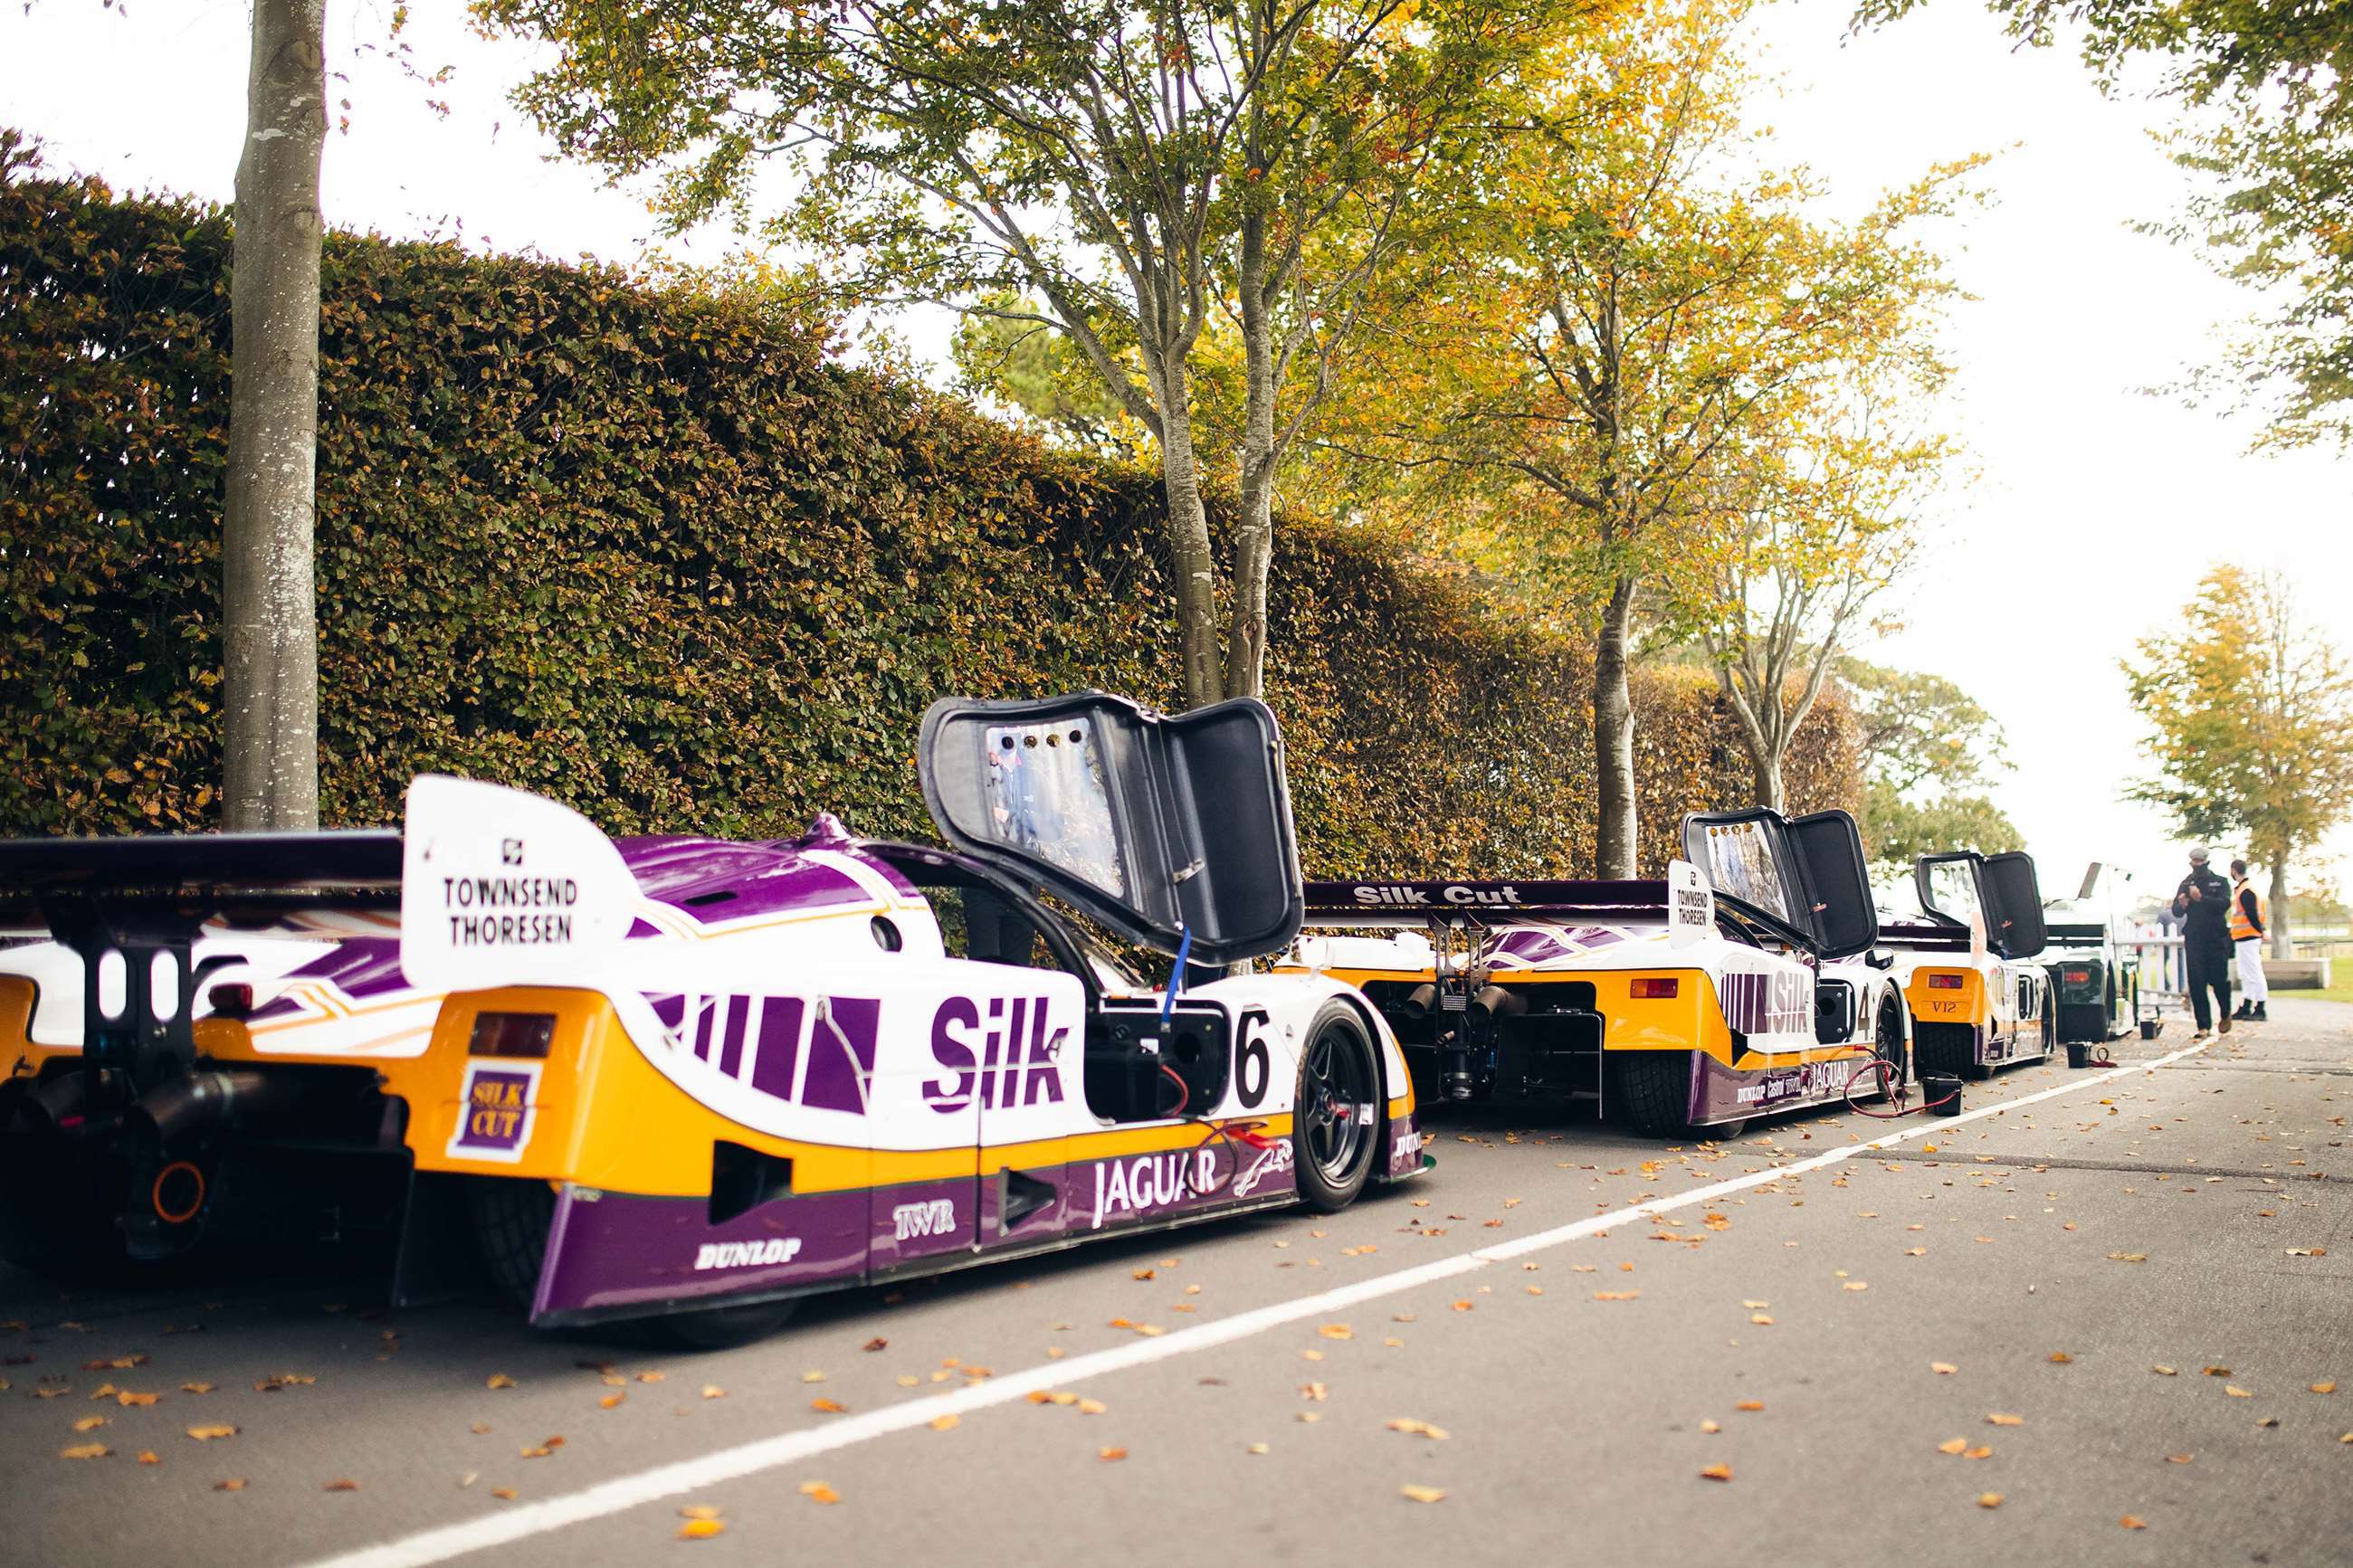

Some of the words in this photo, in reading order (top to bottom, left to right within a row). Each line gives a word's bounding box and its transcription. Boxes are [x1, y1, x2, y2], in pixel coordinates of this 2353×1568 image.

[443, 878, 577, 908] TOWNSEND
[1353, 886, 1432, 904] Silk
[1443, 886, 1522, 904] Cut
[1678, 889, 1708, 908] TOWNSEND
[451, 916, 572, 946] THORESEN
[1679, 908, 1707, 927] THORESEN
[1773, 970, 1809, 1034] Silk
[1858, 984, 1871, 1041] 4
[922, 996, 1069, 1114] Silk
[1235, 1009, 1270, 1108] 6
[473, 1081, 525, 1106] SILK
[1738, 1085, 1766, 1103] DUNLOP
[1811, 1061, 1849, 1097] JAGUAR
[472, 1110, 521, 1138] CUT
[1091, 1149, 1216, 1230] JAGUAR
[892, 1199, 956, 1240] TWR
[694, 1238, 802, 1270] DUNLOP
